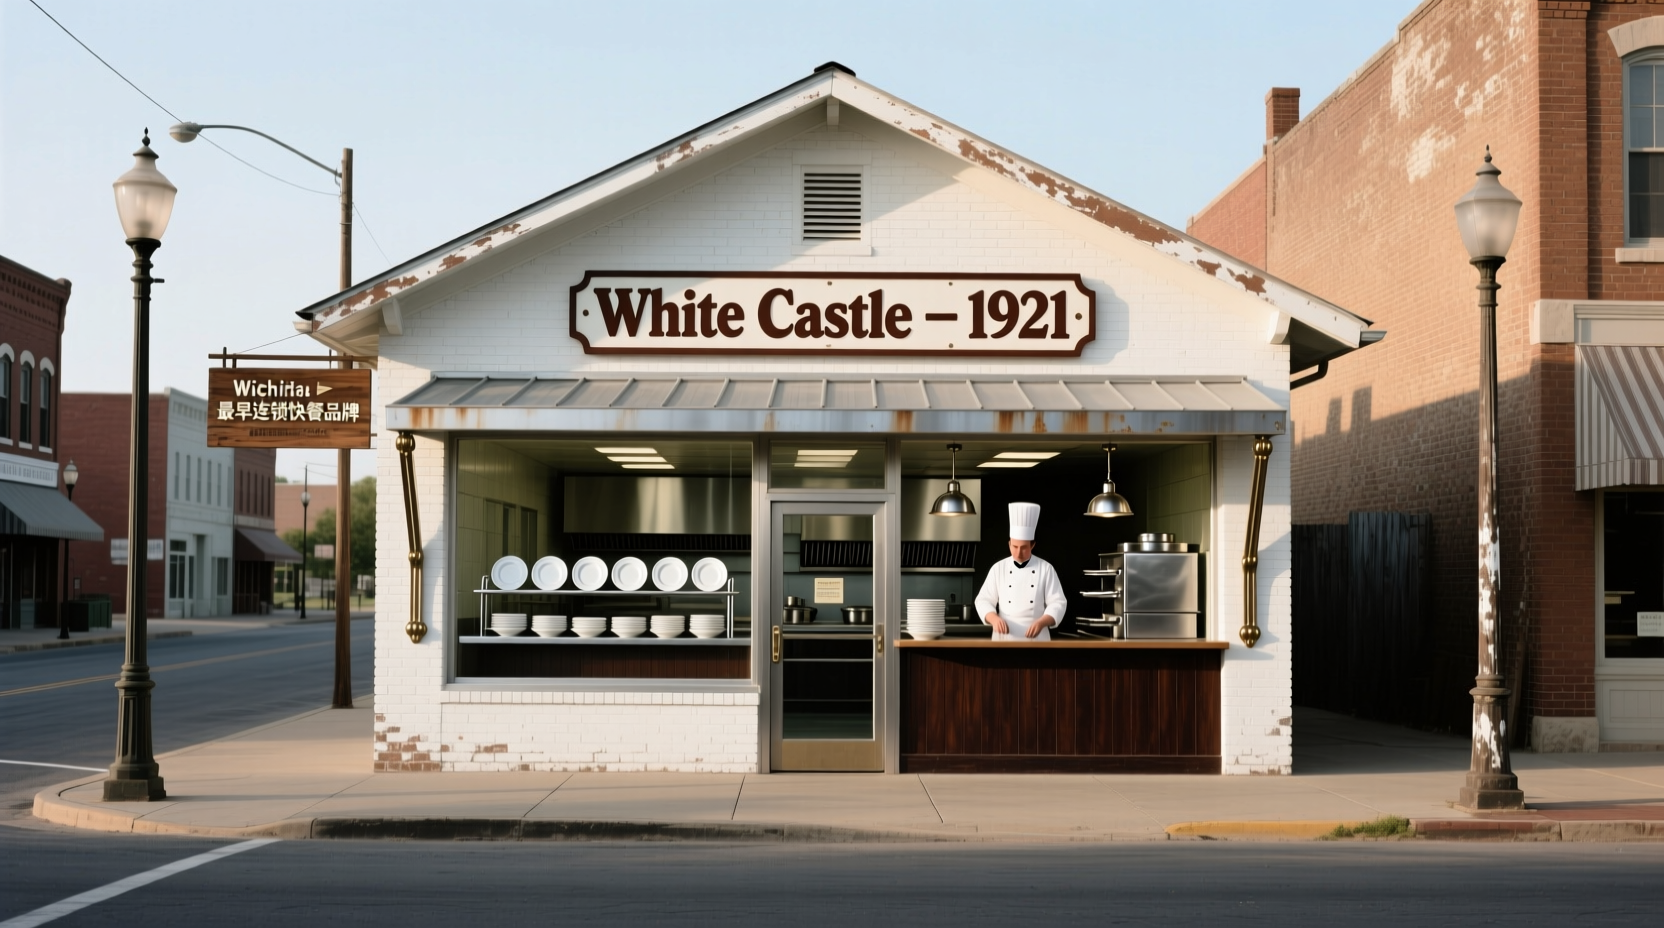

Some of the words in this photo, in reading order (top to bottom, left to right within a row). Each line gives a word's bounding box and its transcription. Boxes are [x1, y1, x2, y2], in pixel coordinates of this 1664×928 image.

[593, 287, 744, 338] White
[757, 287, 913, 339] Castle
[968, 289, 1070, 339] 1921
